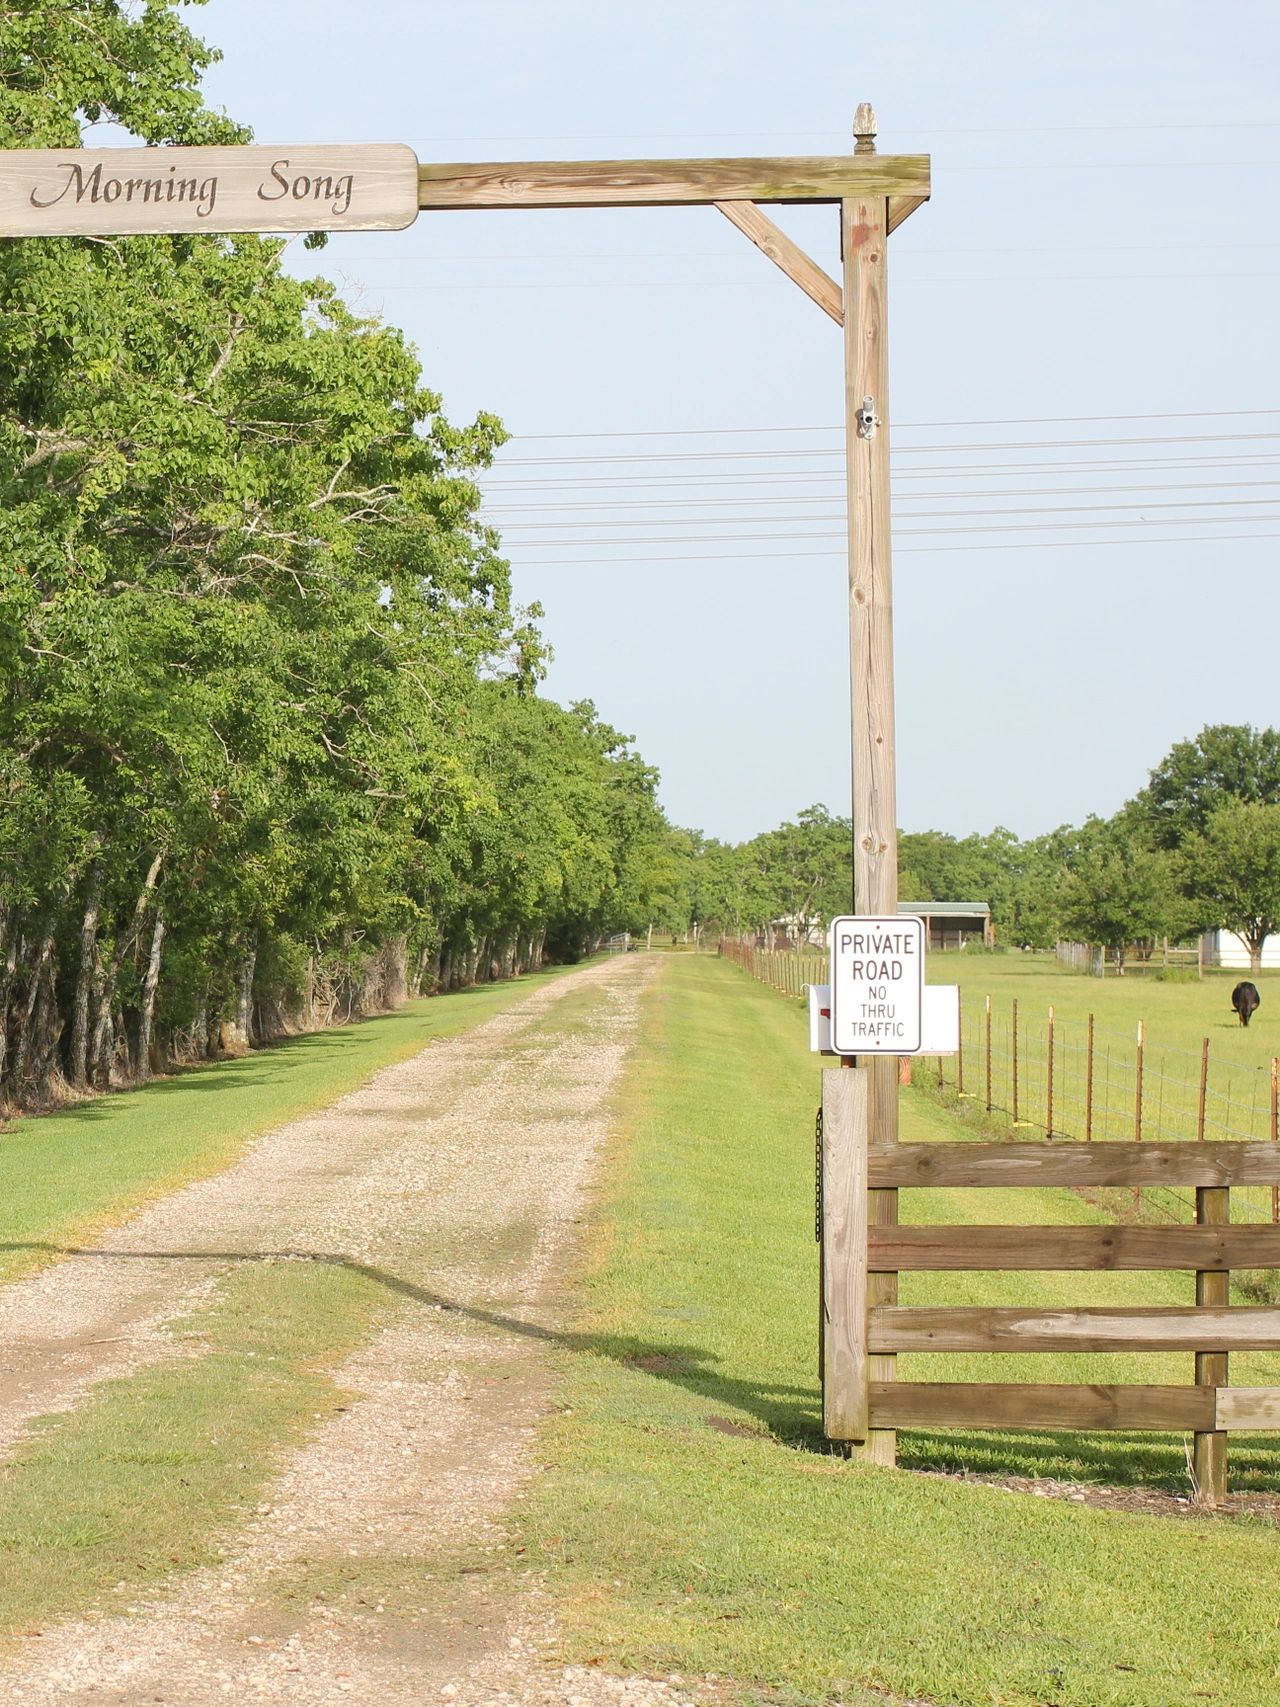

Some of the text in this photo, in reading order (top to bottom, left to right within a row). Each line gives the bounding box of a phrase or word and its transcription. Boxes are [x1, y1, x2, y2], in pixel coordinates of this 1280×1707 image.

[29, 159, 355, 218] Morning Song
[841, 934, 914, 954] PRIVATE
[852, 960, 903, 980] ROAD
[868, 985, 887, 1000] NO
[860, 1004, 895, 1019] THRU
[851, 1022, 904, 1037] TRAFFIC
